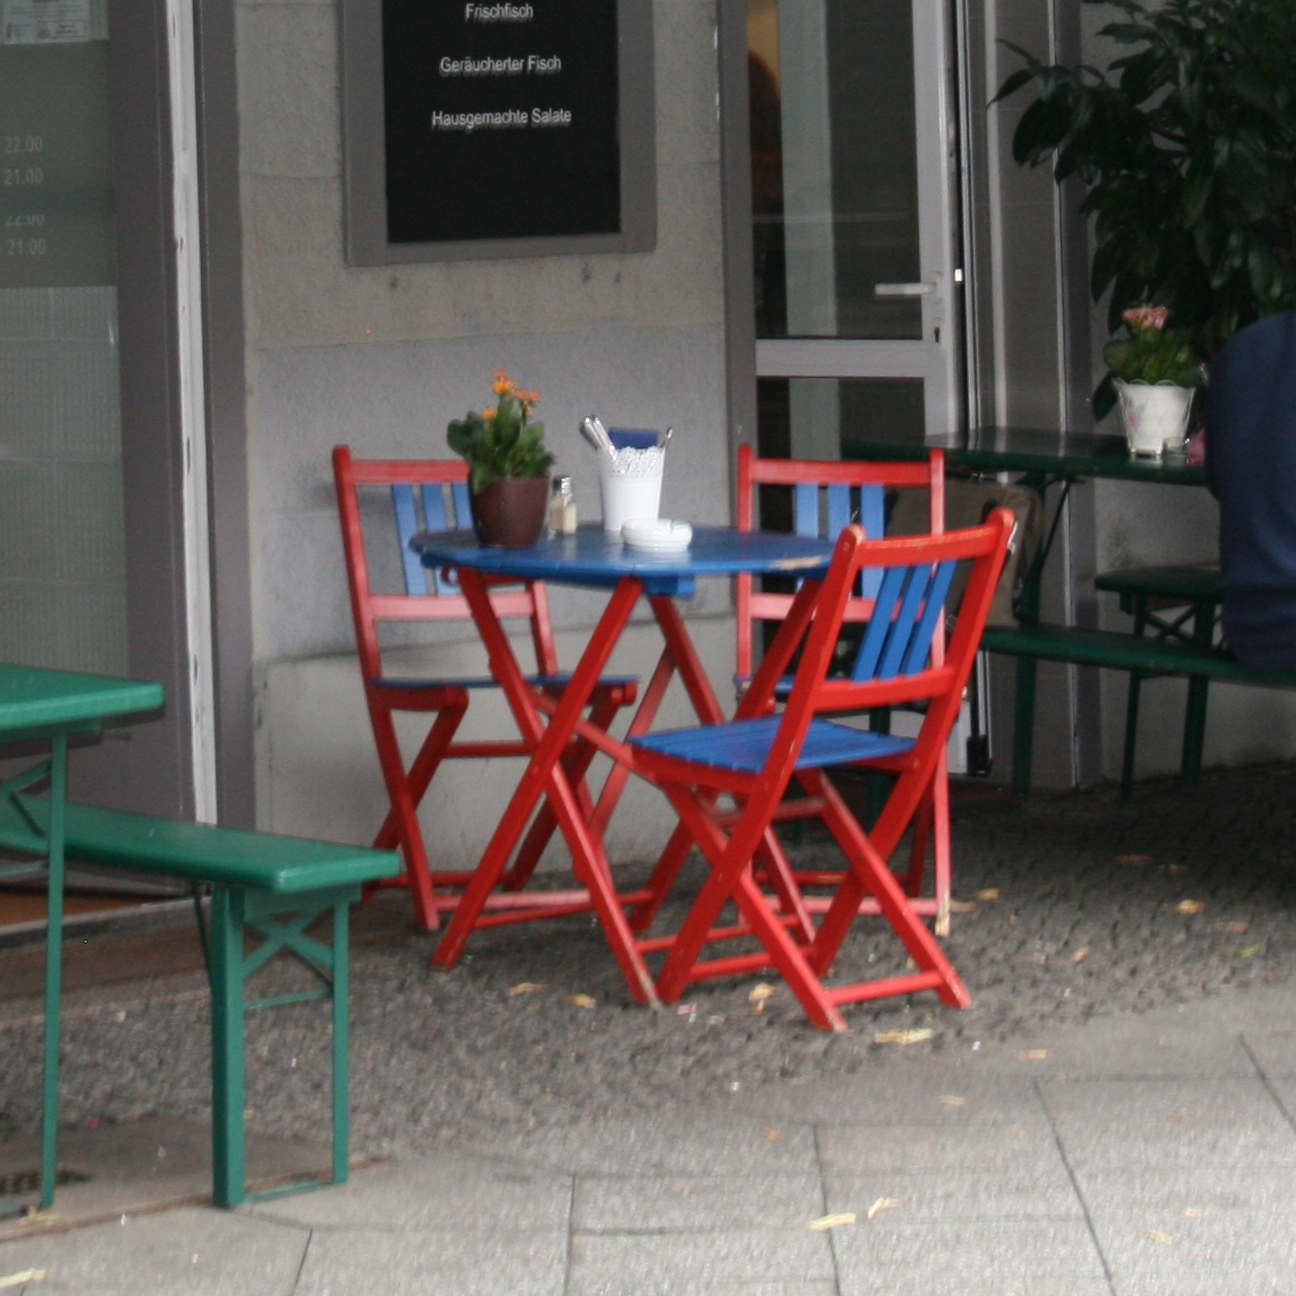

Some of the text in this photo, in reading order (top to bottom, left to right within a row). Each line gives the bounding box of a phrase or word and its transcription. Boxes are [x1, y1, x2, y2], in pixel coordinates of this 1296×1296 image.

[465, 2, 534, 21] Frischfisch
[440, 54, 562, 74] Geräucherter Fisch
[432, 106, 572, 129] Hausgemachte Salate
